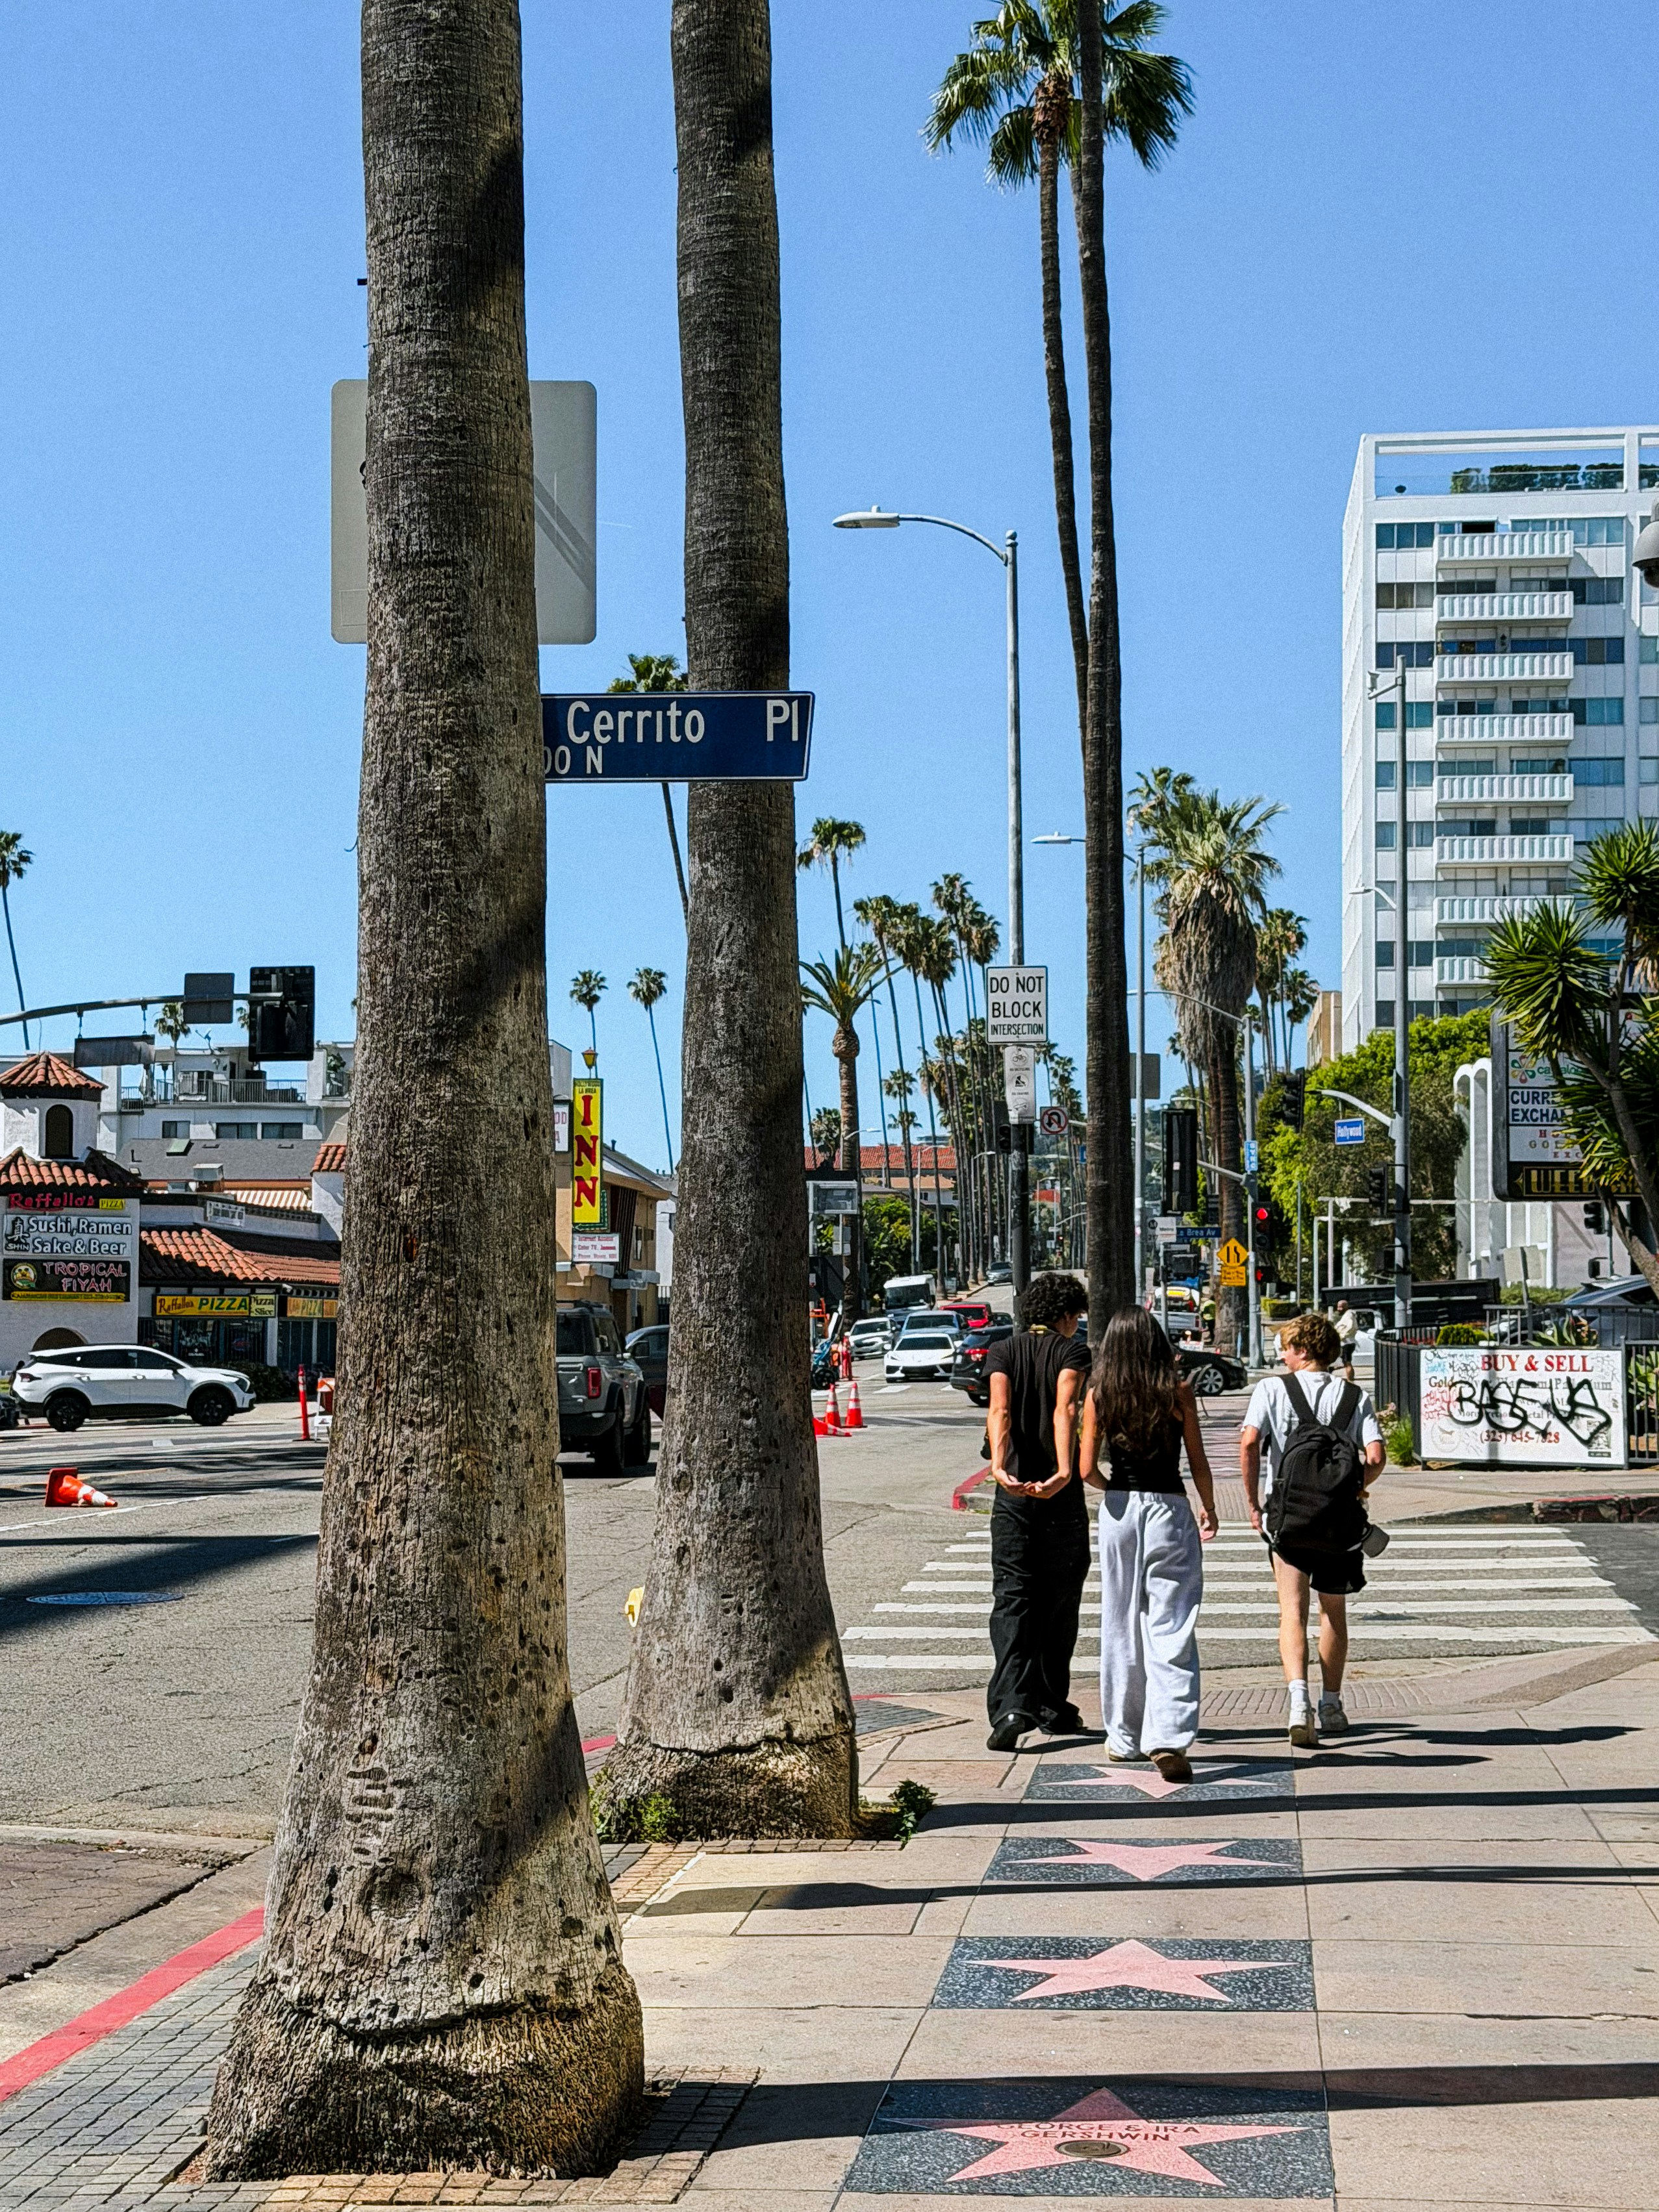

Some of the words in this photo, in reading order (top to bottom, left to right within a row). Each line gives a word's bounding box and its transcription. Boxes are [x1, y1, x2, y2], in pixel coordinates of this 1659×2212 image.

[567, 700, 705, 744] Cerrito
[766, 699, 799, 742] Pl
[586, 745, 603, 774] N
[990, 976, 1009, 993] DO
[1016, 975, 1044, 993] NOT
[992, 1001, 1042, 1018] BLOCK
[991, 1023, 1044, 1035] INTERSECTION
[574, 1094, 599, 1208] INN
[6, 1242, 30, 1251] SHIN
[33, 1238, 71, 1253] Sake
[74, 1238, 86, 1254] &
[90, 1240, 127, 1255] Beer
[43, 1262, 127, 1277] TROPICAL
[61, 1277, 112, 1292] FIYAH
[198, 1298, 248, 1311] PIZZA
[1480, 1354, 1519, 1371] BUY
[1525, 1355, 1538, 1372] &
[1544, 1355, 1593, 1372] SELL
[998, 2122, 1114, 2131] GEORGE
[1156, 2126, 1200, 2134] IRA
[1020, 2130, 1170, 2141] GERSHWIN
